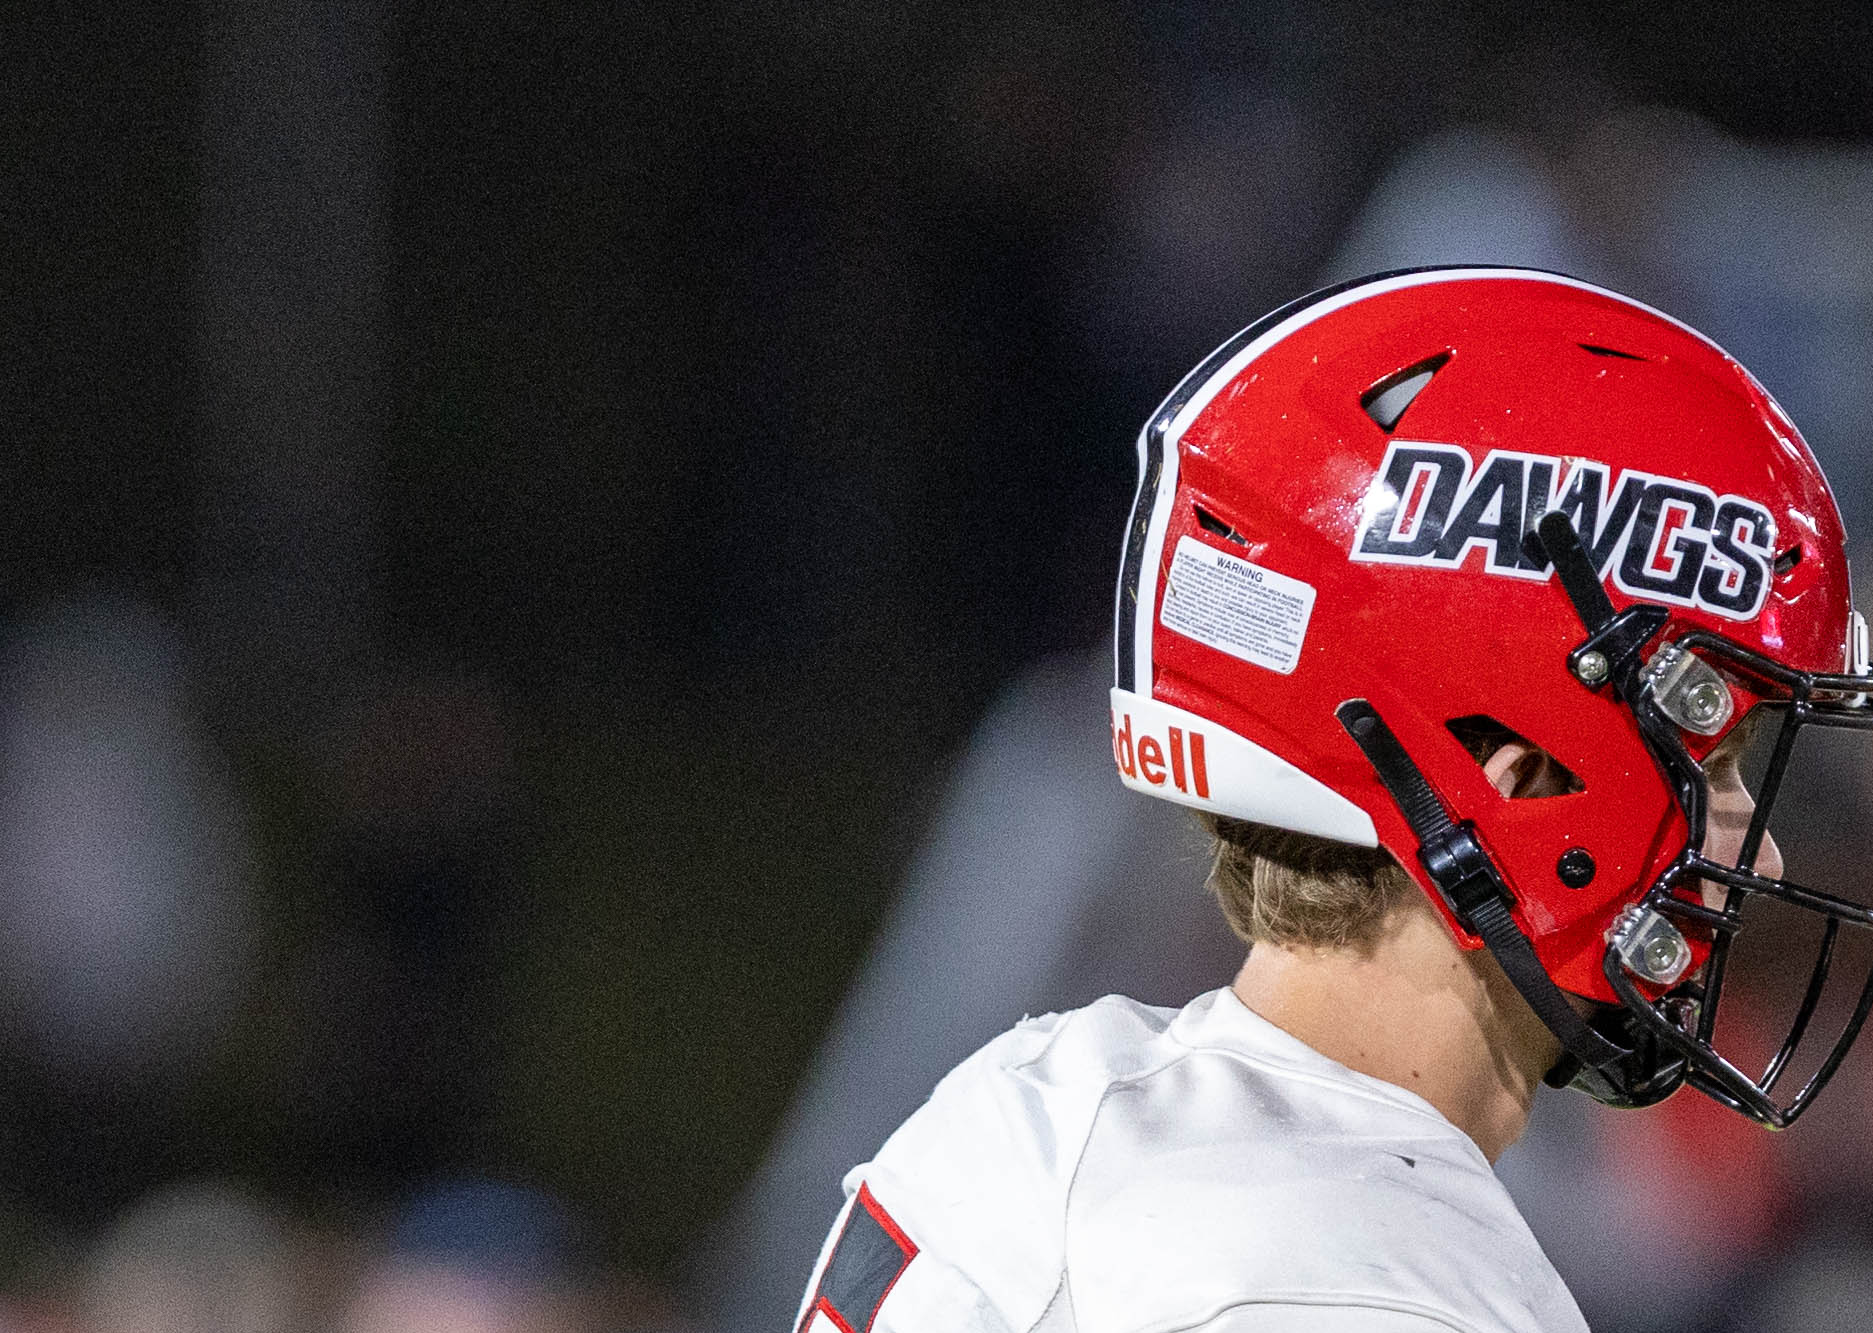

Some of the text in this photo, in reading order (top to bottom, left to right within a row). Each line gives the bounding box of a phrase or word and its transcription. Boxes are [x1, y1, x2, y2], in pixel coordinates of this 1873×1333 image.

[1217, 556, 1263, 582] WARNING
[1351, 441, 1776, 621] DAWGS
[1111, 710, 1209, 798] dell
